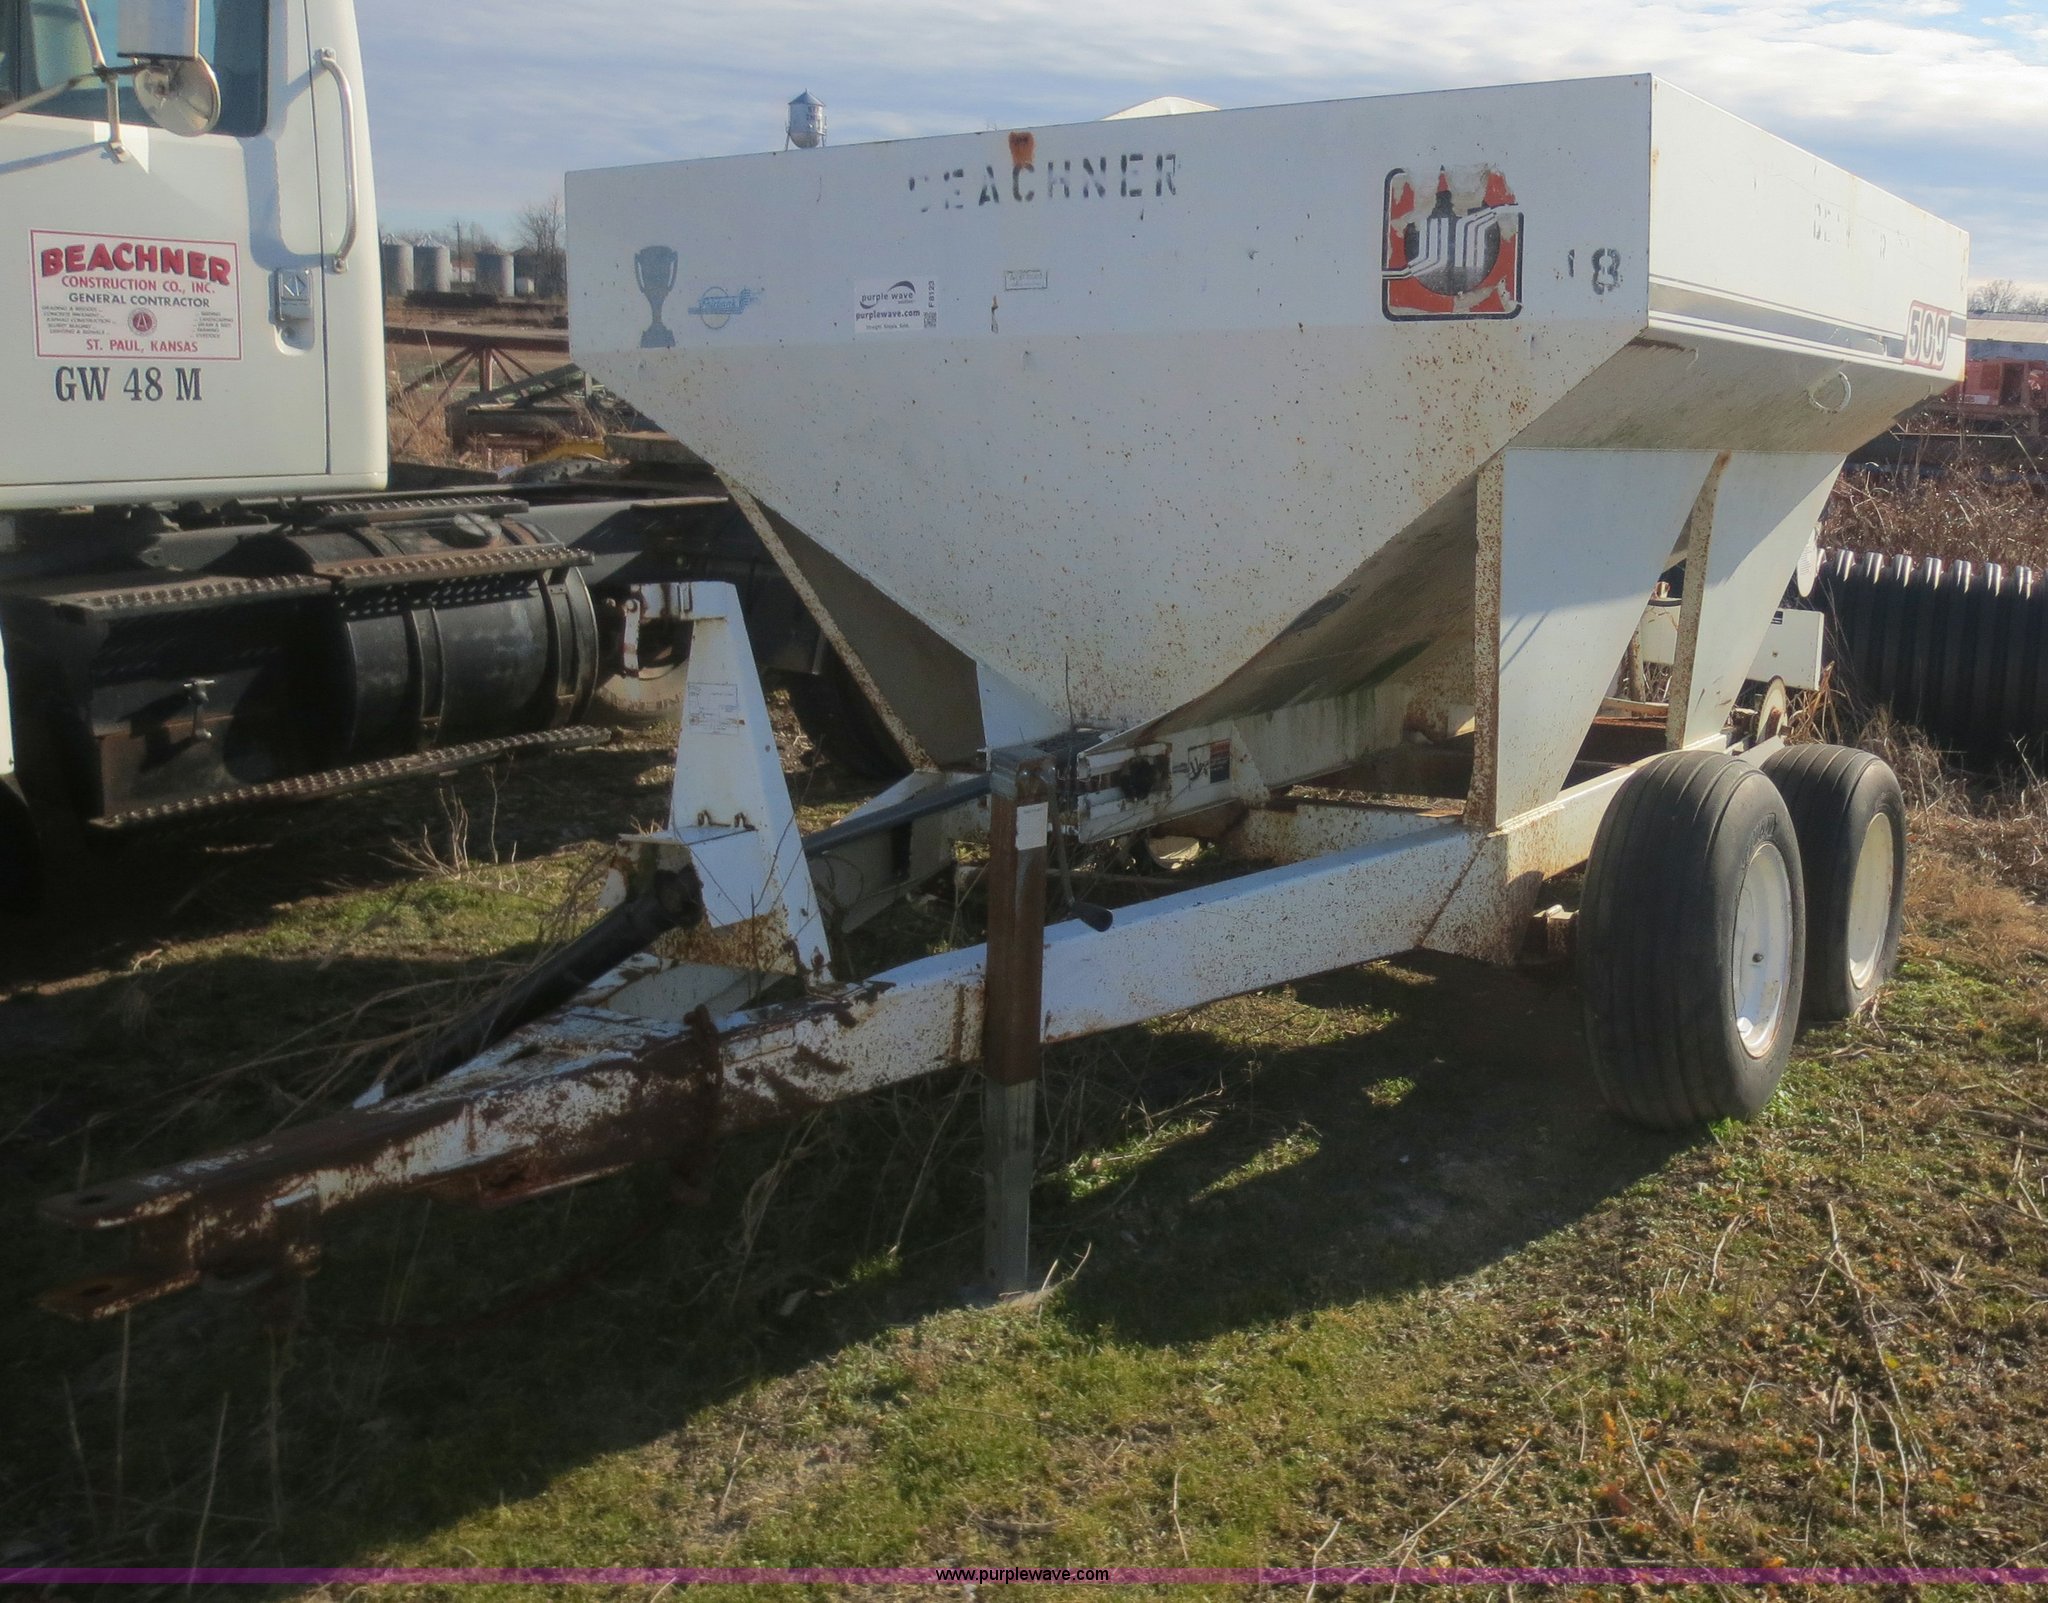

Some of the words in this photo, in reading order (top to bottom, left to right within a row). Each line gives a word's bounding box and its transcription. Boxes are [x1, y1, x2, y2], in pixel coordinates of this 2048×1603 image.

[41, 242, 231, 286] BEACHNER
[61, 275, 157, 291] CONSTRUCTION
[162, 280, 185, 294] CO.,
[191, 282, 215, 294] INC.
[68, 292, 127, 305] GENERAL
[130, 295, 210, 308] CONTRACTOR
[861, 292, 888, 302] purple
[891, 292, 914, 300] wave
[855, 309, 921, 321] purplewave.com
[86, 339, 103, 351] ST.
[109, 339, 145, 353] PAUL,
[150, 340, 198, 352] KANSAS
[55, 365, 111, 401] GW
[123, 366, 164, 401] 48
[175, 367, 203, 401] M
